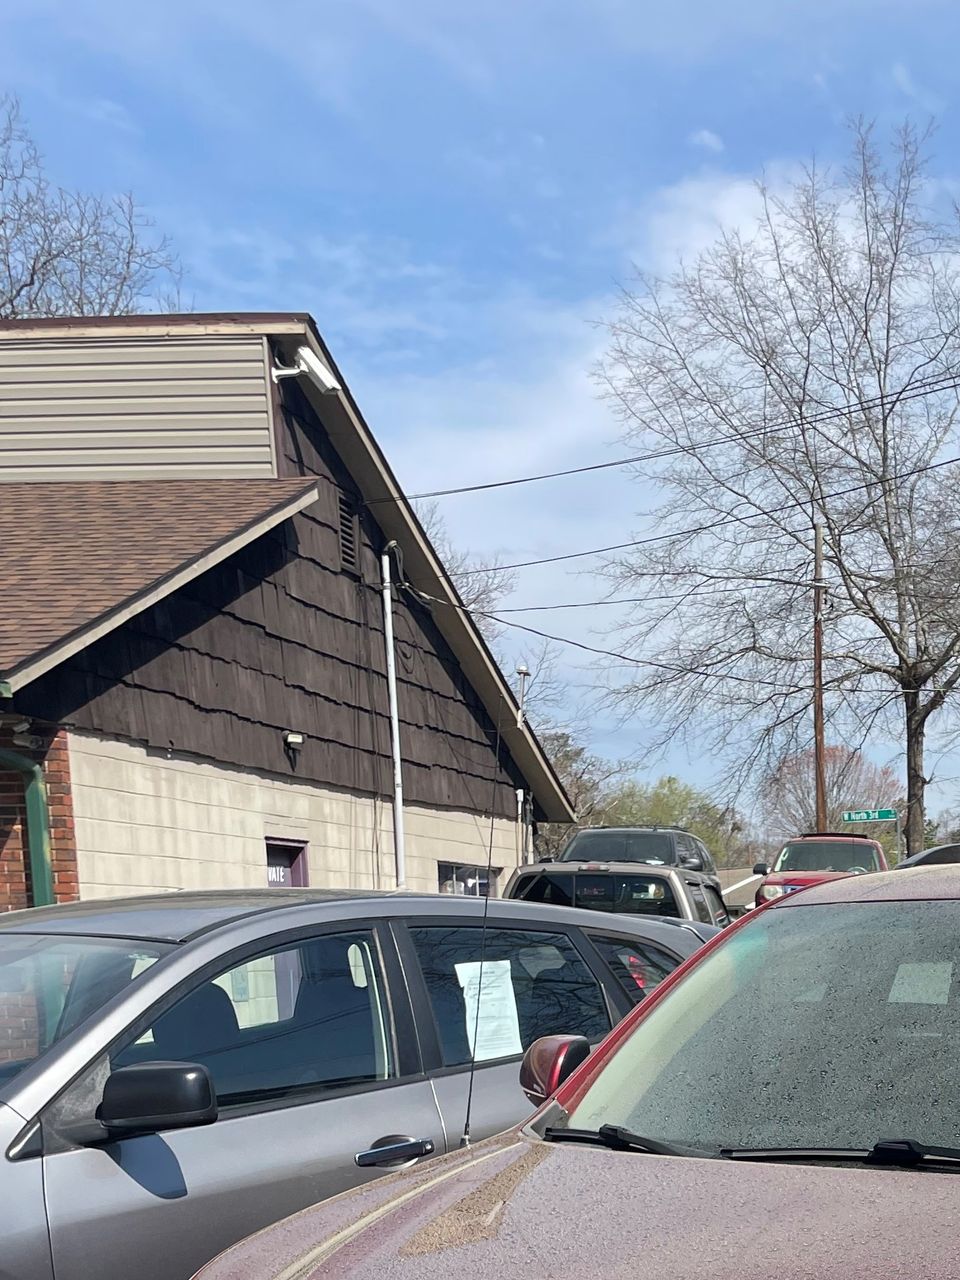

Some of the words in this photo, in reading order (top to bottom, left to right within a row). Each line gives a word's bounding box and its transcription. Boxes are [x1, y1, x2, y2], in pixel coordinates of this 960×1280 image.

[850, 811, 867, 820] North
[868, 810, 879, 819] 3rd
[267, 866, 285, 882] VATE
